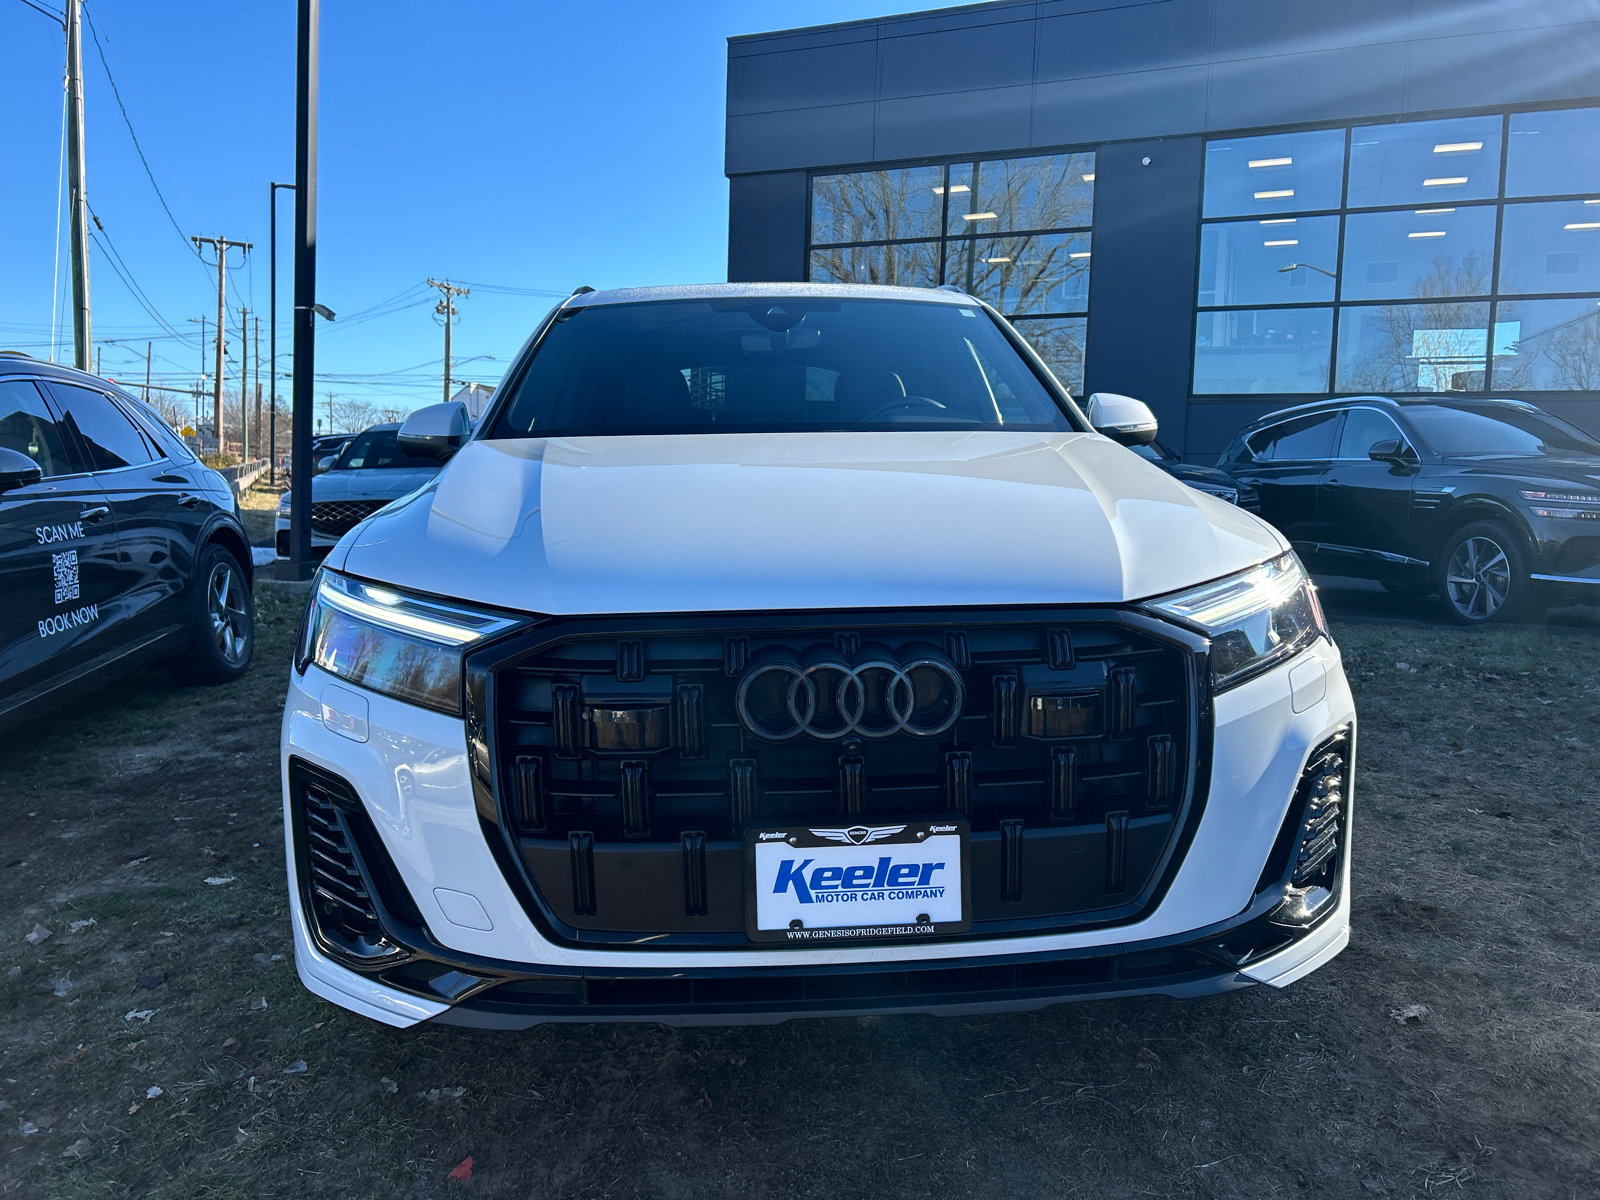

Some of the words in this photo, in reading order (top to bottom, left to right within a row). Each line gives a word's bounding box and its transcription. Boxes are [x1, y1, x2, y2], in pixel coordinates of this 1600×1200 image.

[35, 524, 69, 545] SCAN
[69, 521, 86, 540] ME
[37, 612, 73, 638] BOOK
[71, 603, 99, 627] NOW
[758, 832, 788, 840] Keeler
[929, 825, 958, 834] Keeler
[772, 856, 946, 904] Keeler
[815, 892, 857, 903] MOTOR
[860, 891, 885, 901] CAR
[888, 888, 945, 900] COMPANY
[786, 925, 935, 940] WWW.GENESISOFRIDGEFIELD.COM
